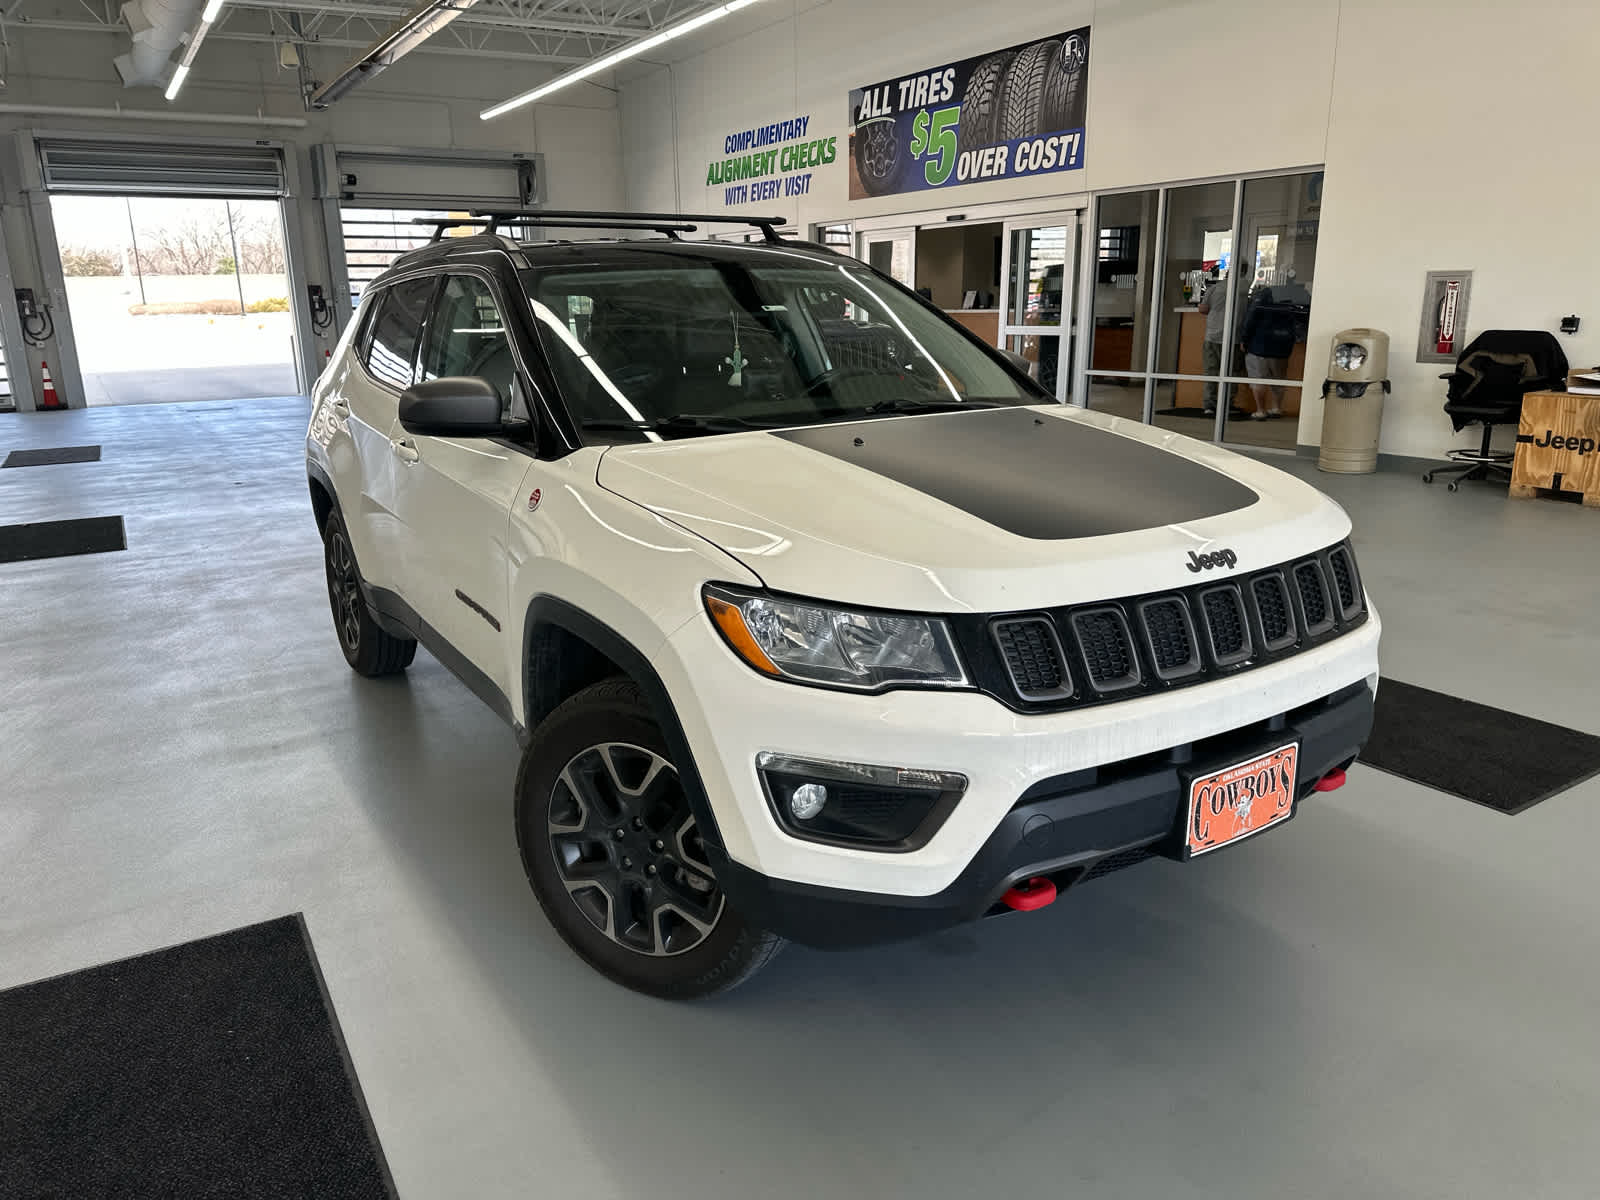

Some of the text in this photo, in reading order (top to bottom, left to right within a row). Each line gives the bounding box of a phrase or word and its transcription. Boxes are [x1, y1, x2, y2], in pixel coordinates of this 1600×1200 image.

[859, 68, 956, 121] ALL TIRES
[724, 116, 810, 155] COMPLIMENTARY
[910, 106, 961, 186] $5
[956, 133, 1081, 181] OVER COST!
[706, 136, 837, 187] ALIGNMENT CHECKS
[725, 173, 812, 206] WITH EVERY VISIT
[1535, 430, 1595, 455] Jeep
[1185, 548, 1238, 574] Jeep
[1193, 753, 1293, 842] COWBOYS
